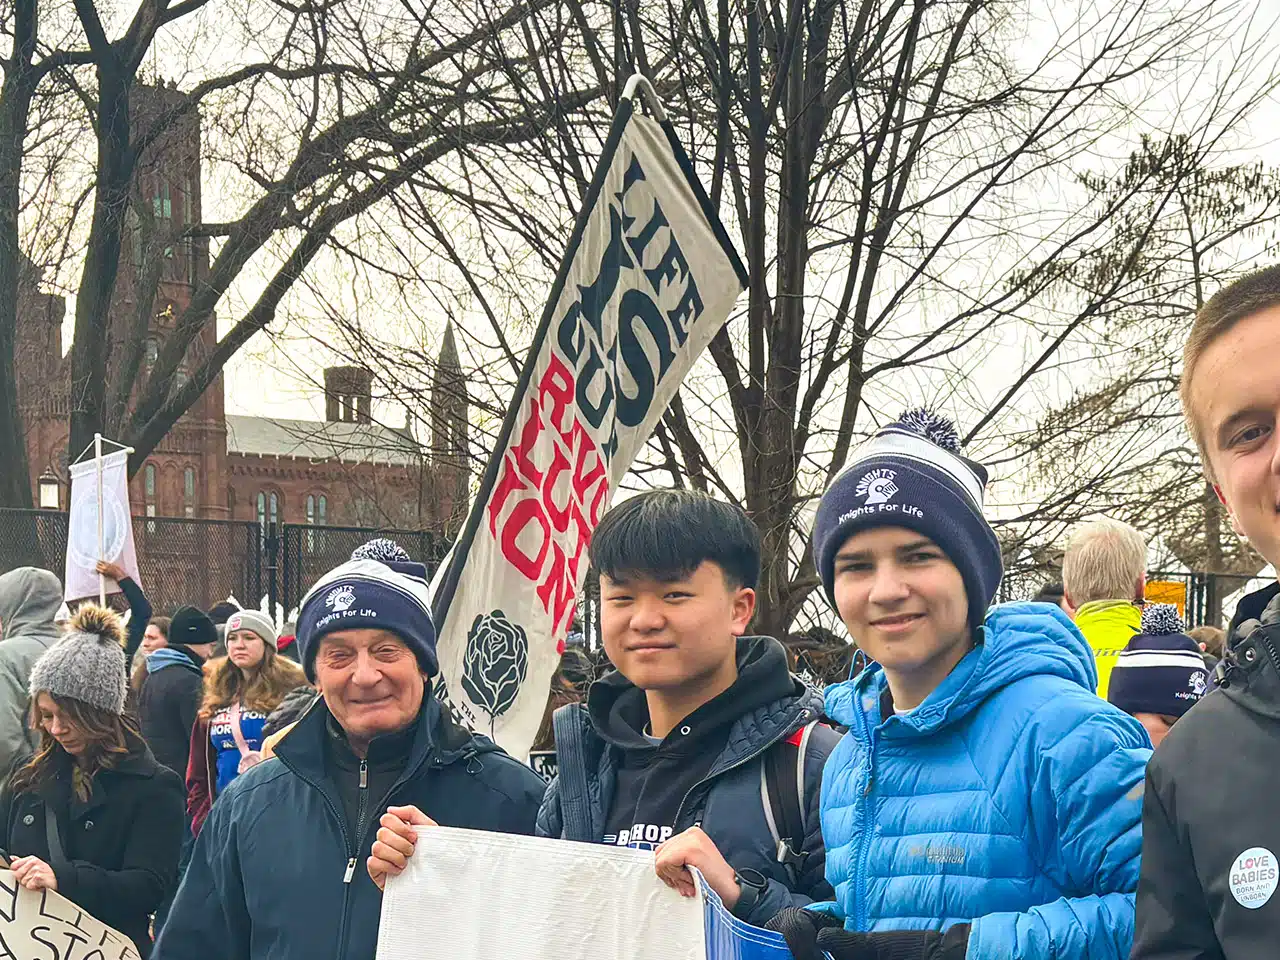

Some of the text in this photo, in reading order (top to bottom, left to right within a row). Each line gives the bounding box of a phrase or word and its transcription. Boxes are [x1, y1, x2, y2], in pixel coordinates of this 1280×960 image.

[614, 150, 705, 348] LIFE
[855, 468, 898, 497] KNIGHTS
[838, 503, 924, 525] Knights For Life
[1239, 856, 1269, 870] LOVE
[1232, 868, 1276, 886] BABIES
